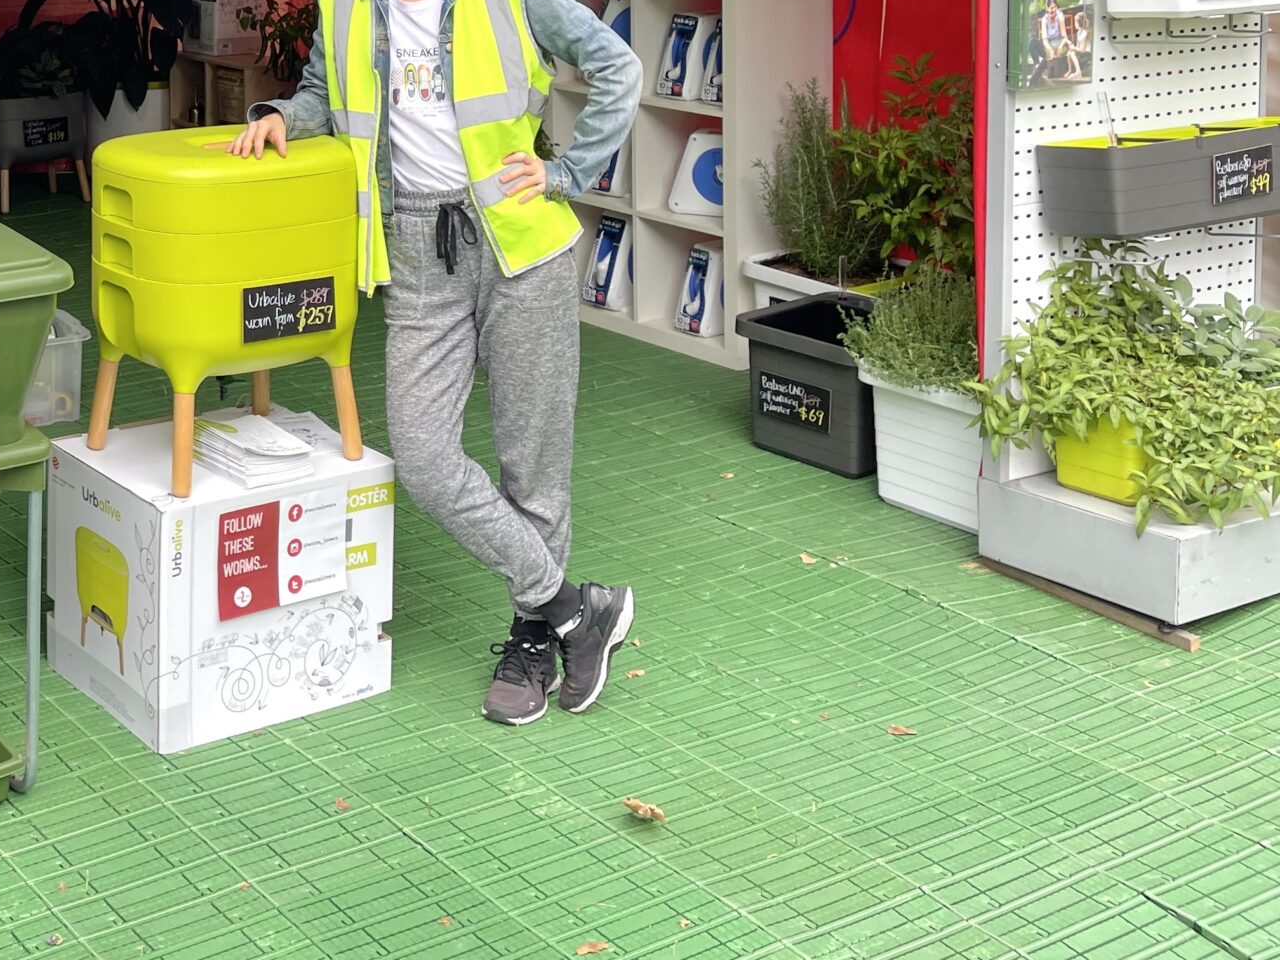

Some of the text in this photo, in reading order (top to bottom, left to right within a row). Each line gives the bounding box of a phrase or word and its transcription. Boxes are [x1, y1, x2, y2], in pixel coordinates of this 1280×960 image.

[396, 47, 440, 58] SNEAKE
[1249, 173, 1270, 195] $49
[296, 305, 333, 333] $259
[798, 405, 825, 426] $69
[81, 485, 122, 522] Urbalive
[348, 488, 388, 508] OSTÉR
[223, 511, 263, 535] FOLLOW
[172, 519, 184, 578] Urbalive
[223, 535, 255, 556] THESE
[223, 555, 268, 578] WORMS...
[347, 550, 369, 567] RM
